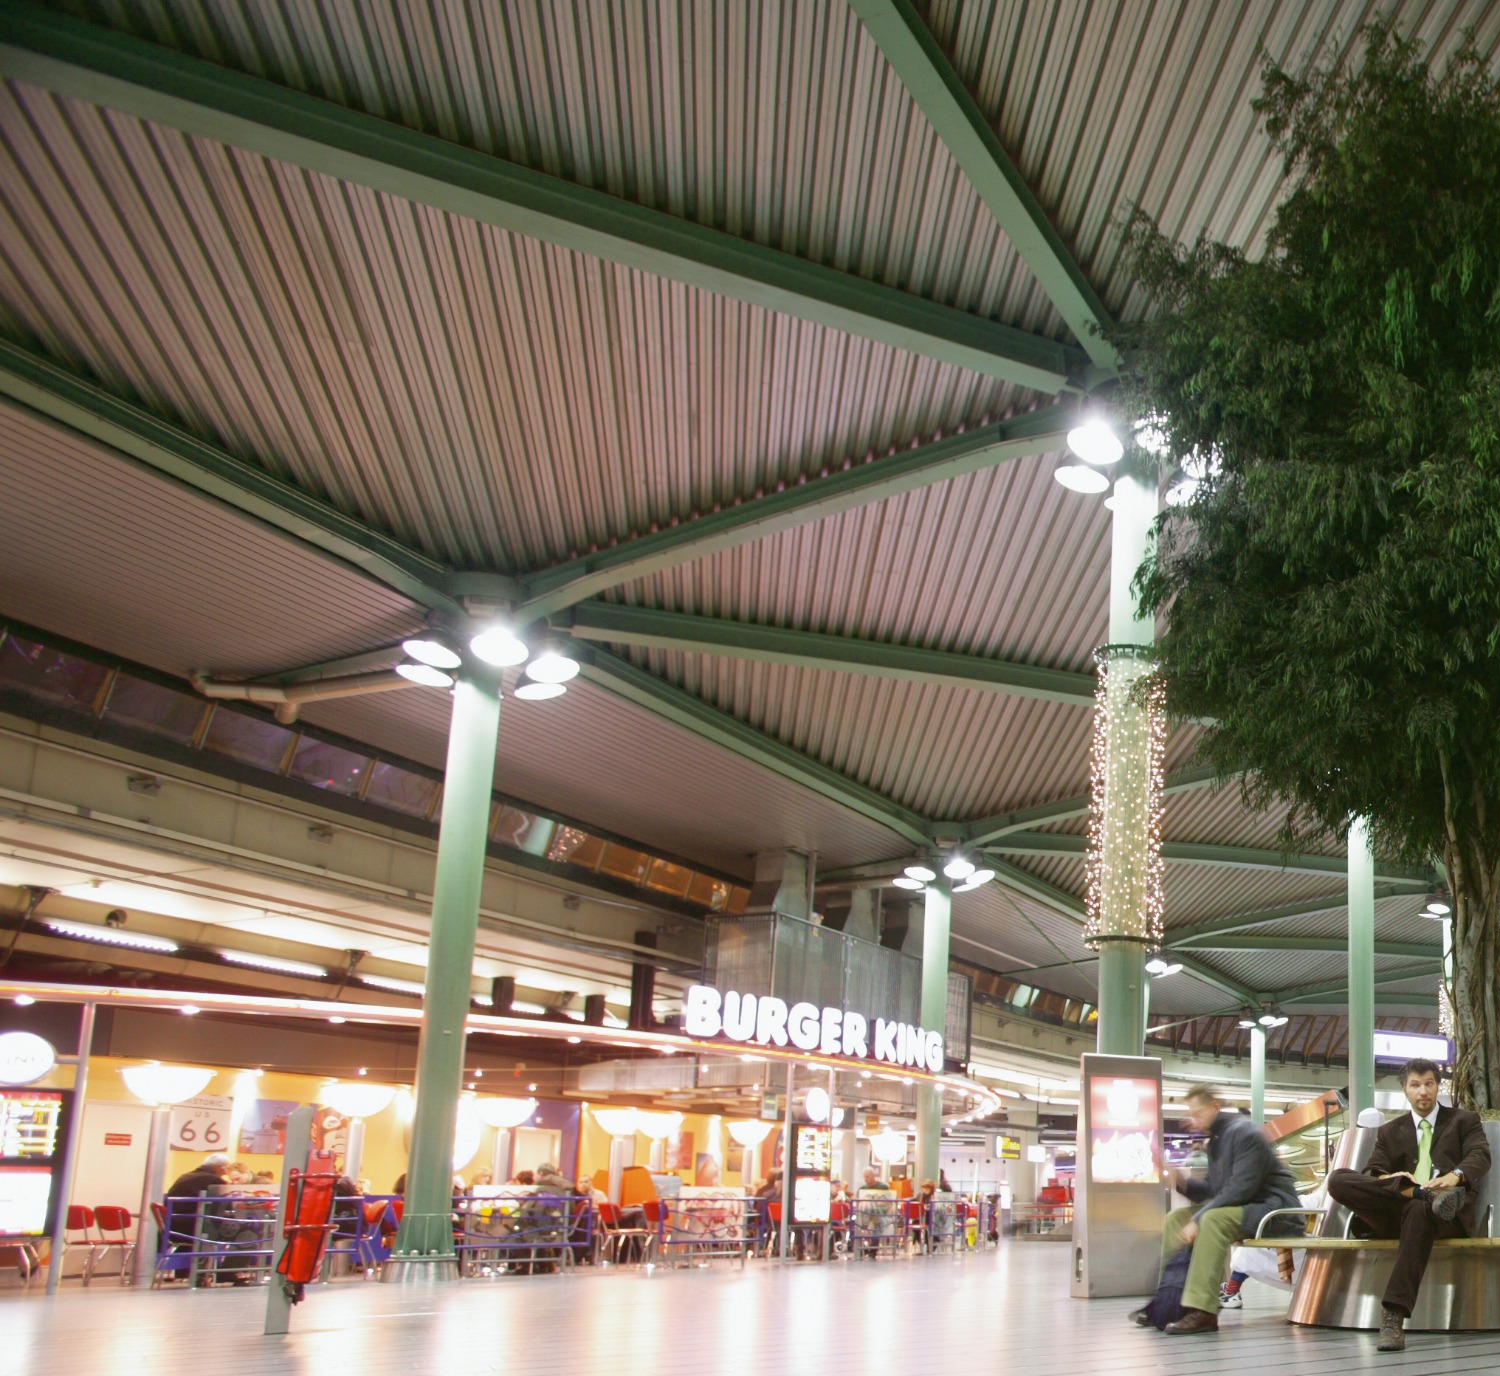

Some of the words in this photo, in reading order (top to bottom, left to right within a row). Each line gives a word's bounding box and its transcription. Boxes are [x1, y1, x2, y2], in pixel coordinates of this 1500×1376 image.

[685, 984, 868, 1059] BURGER
[874, 1017, 944, 1073] KING
[180, 1119, 220, 1144] 66
